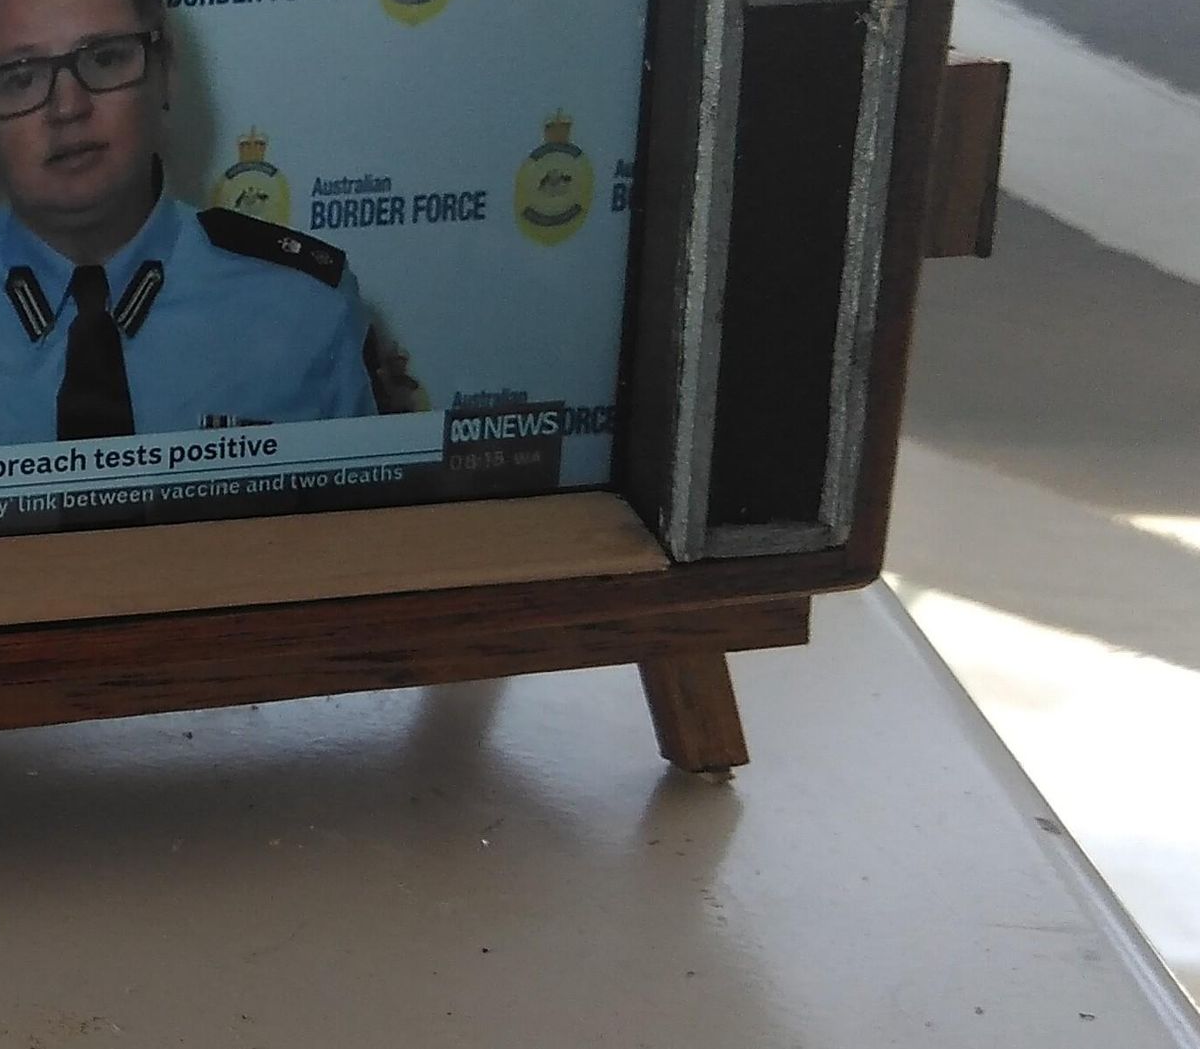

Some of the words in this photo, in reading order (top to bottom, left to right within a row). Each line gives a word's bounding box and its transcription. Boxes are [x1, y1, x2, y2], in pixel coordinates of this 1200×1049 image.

[311, 174, 392, 197] Australian
[310, 196, 403, 230] BORDER
[412, 190, 487, 225] FORCE
[483, 411, 560, 440] NEWS
[94, 444, 162, 469] tests
[169, 434, 278, 468] positive
[18, 495, 57, 513] link
[63, 487, 154, 508] between
[160, 480, 240, 501] vaccine
[247, 473, 285, 493] and
[290, 473, 328, 491] two
[334, 465, 403, 486] deaths
